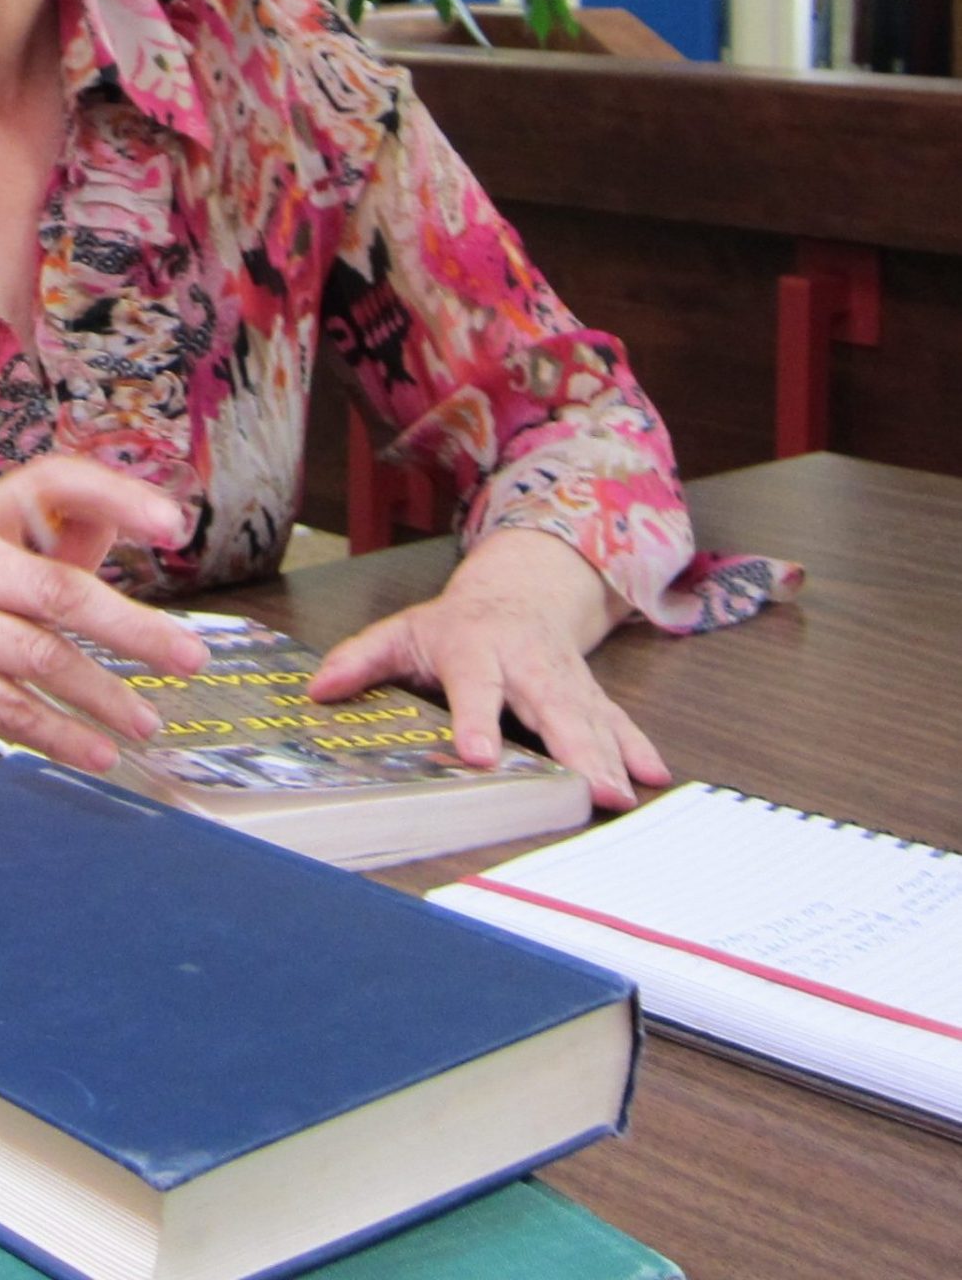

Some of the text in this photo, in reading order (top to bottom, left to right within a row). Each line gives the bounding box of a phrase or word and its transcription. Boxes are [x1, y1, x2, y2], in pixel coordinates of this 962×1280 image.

[123, 672, 314, 689] LOBAL SO
[264, 694, 314, 707] HE
[159, 705, 420, 735] AND THE CIT
